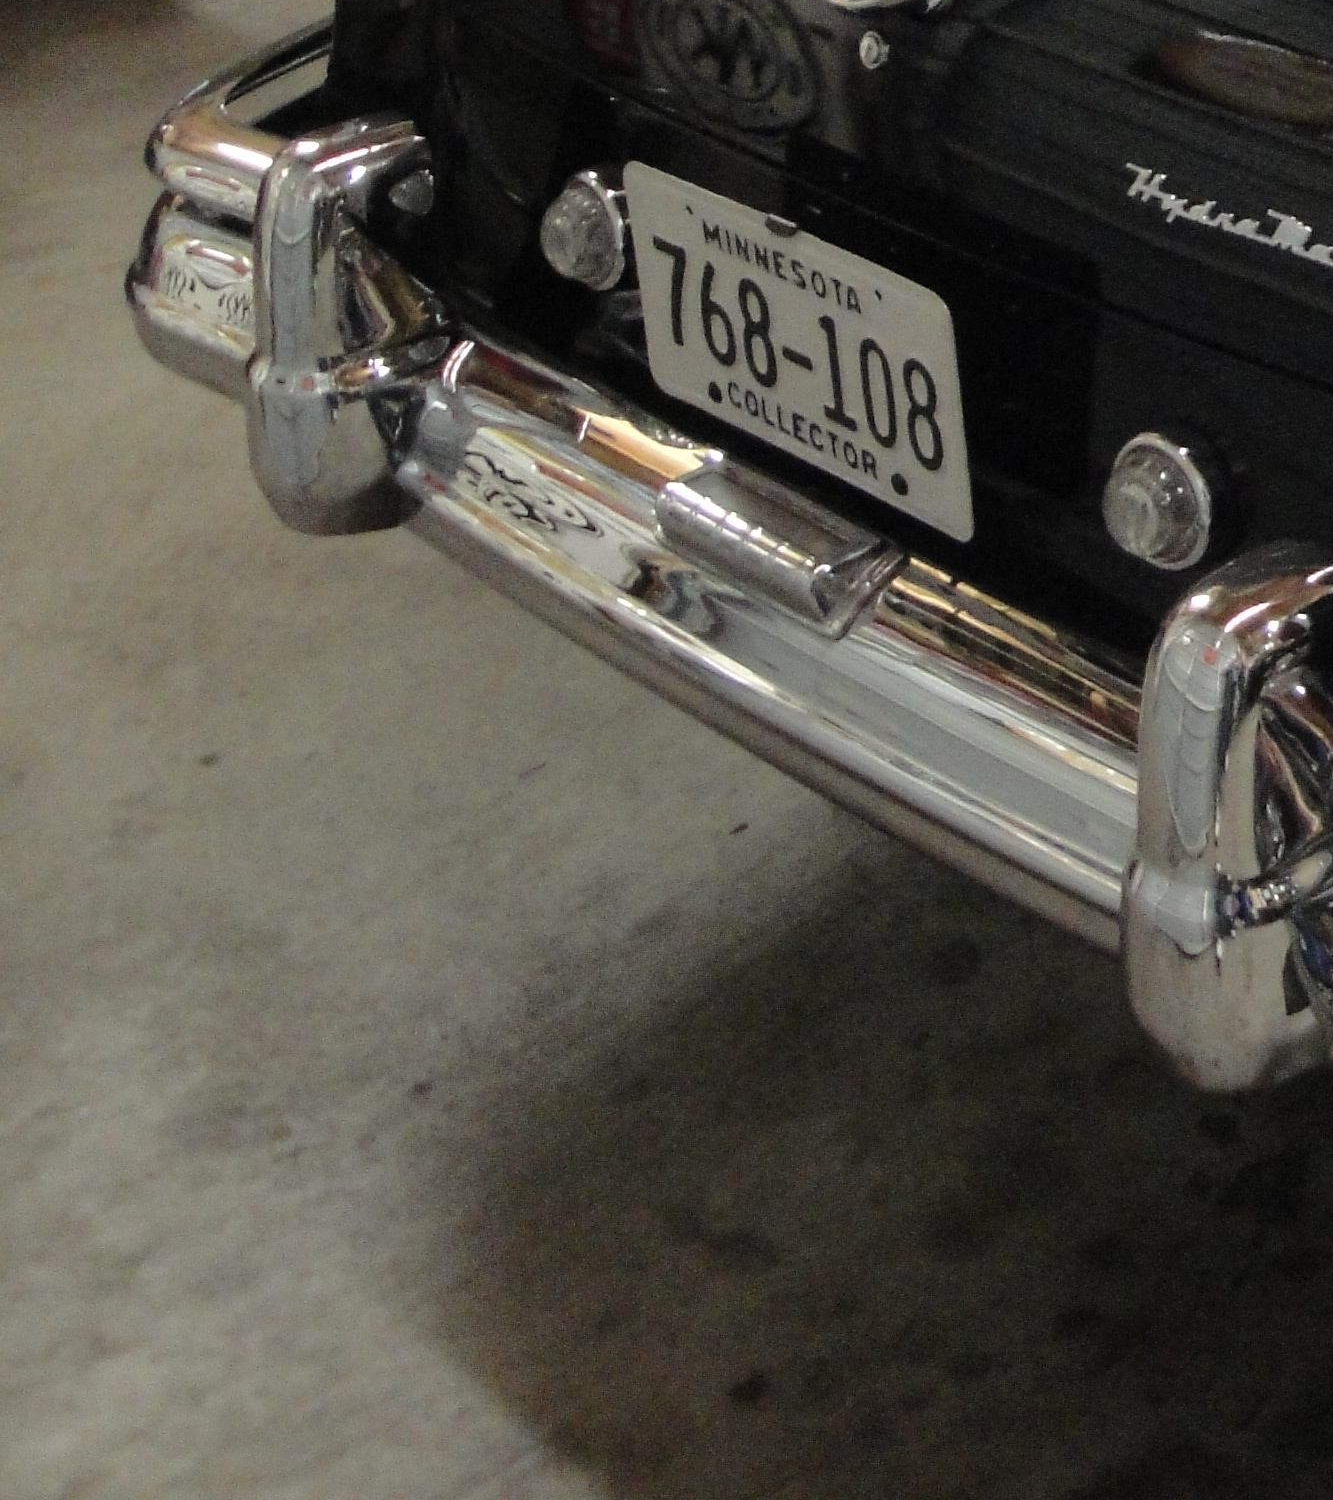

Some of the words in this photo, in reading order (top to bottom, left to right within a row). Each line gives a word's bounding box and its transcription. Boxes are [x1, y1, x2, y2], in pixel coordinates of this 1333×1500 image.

[702, 222, 863, 315] MINNESOTA
[652, 236, 945, 471] 768-108
[727, 381, 879, 479] COLLECTOR
